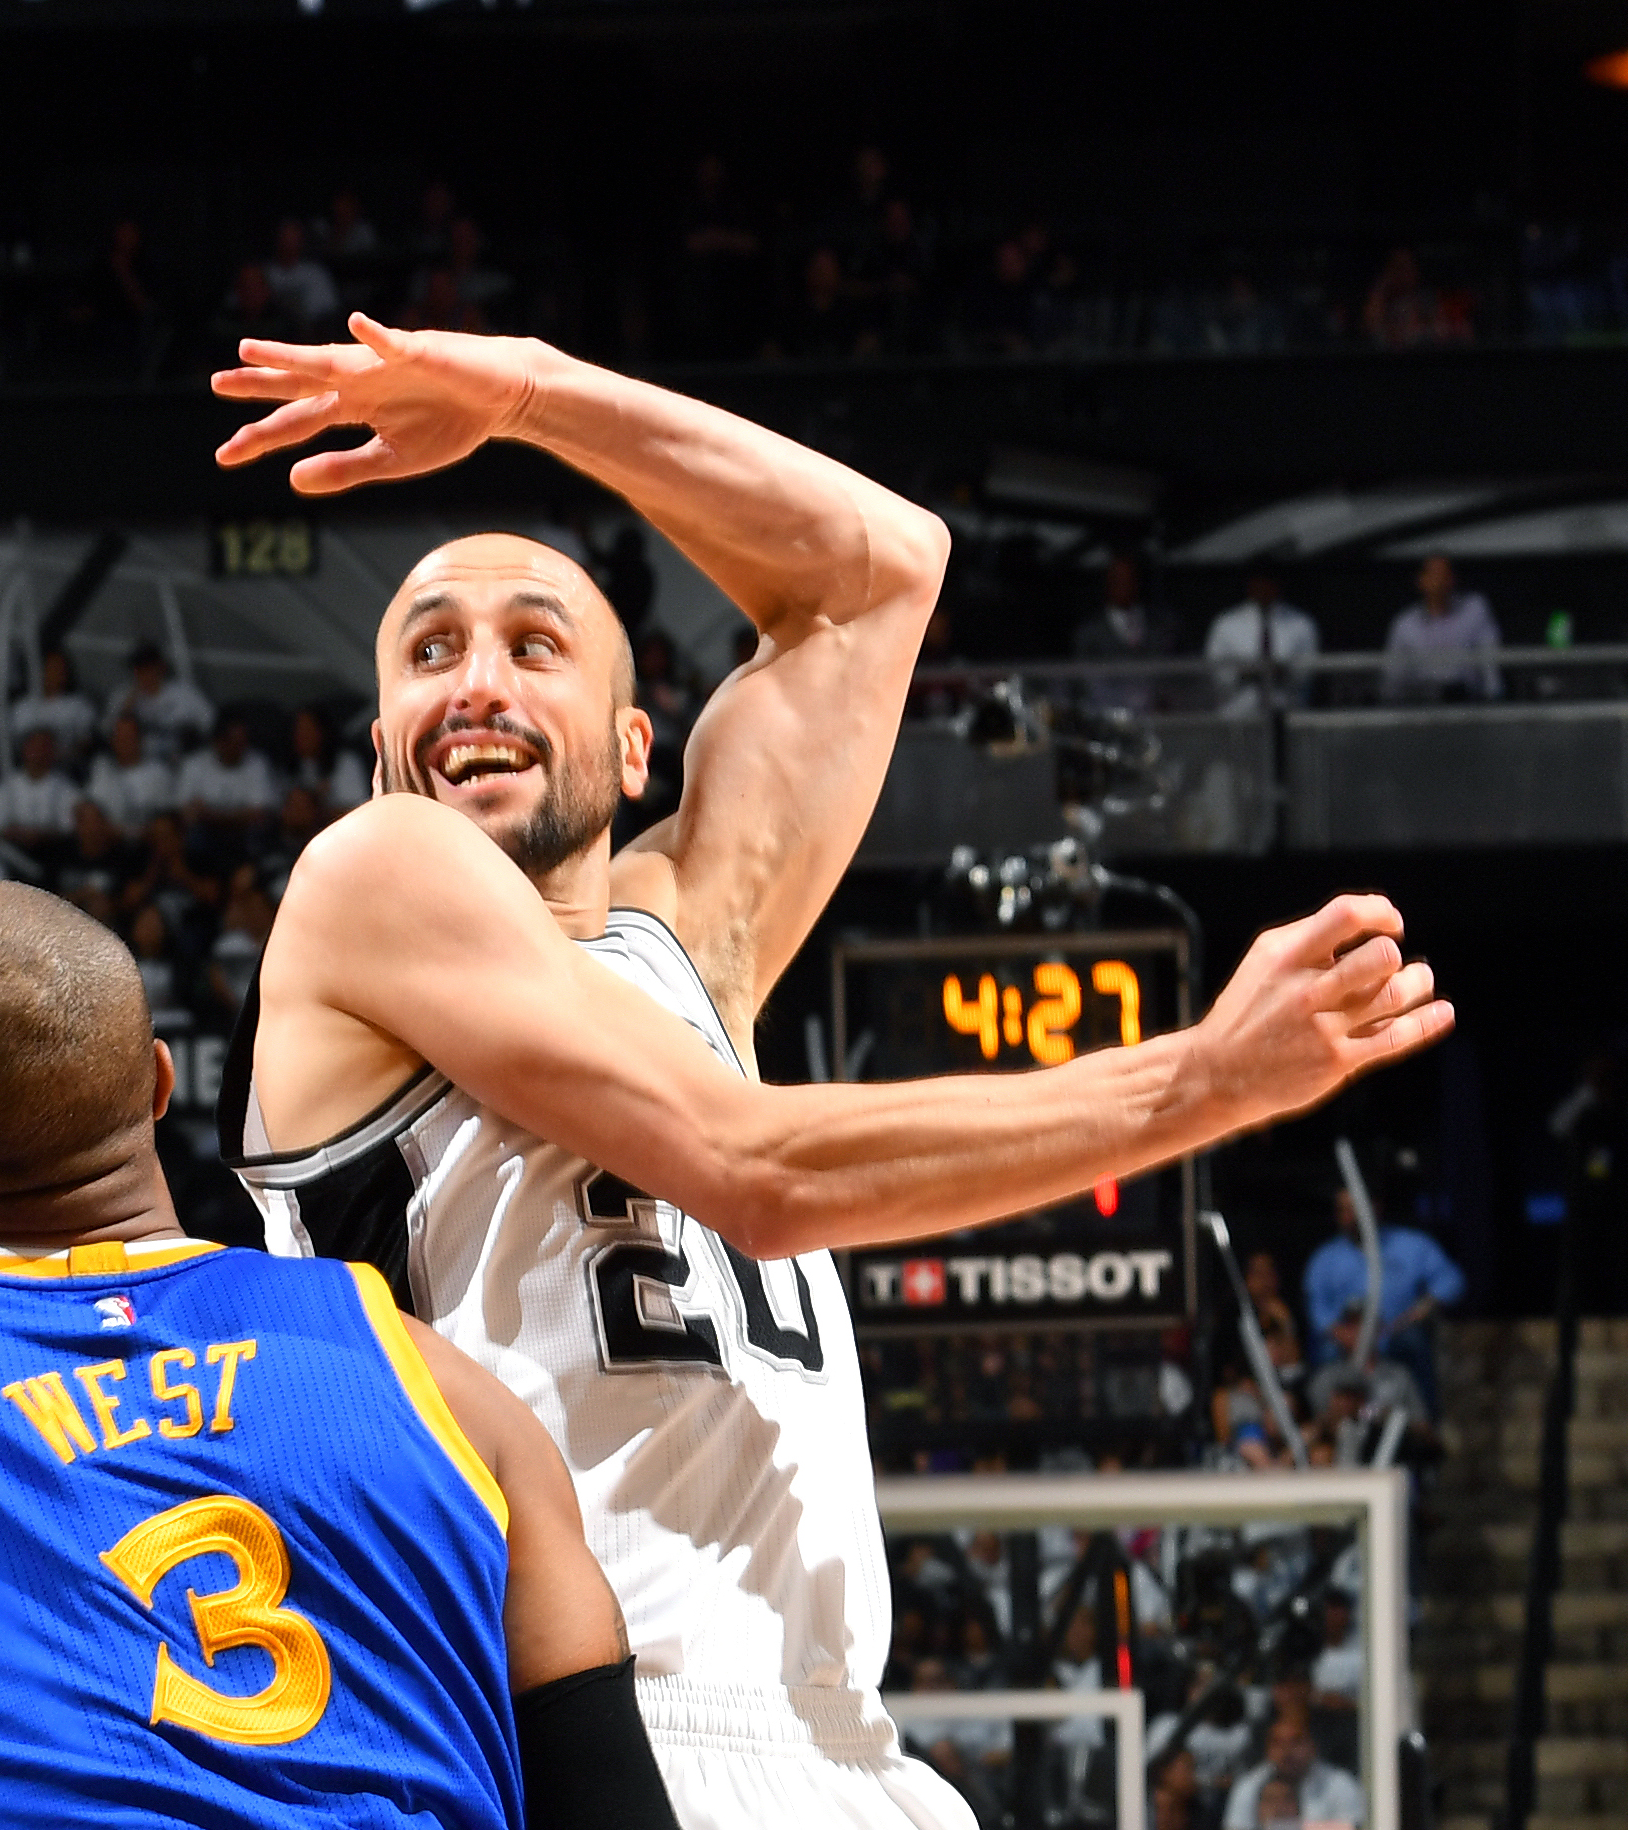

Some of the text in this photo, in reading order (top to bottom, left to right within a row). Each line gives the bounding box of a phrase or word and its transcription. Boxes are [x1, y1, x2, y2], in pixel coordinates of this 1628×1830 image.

[221, 523, 311, 573] 128
[943, 959, 1142, 1066] 4:27
[575, 1167, 830, 1387] 20
[948, 1250, 1172, 1299] TISSOT
[1, 1338, 258, 1464] WEST
[99, 1493, 331, 1746] 3
